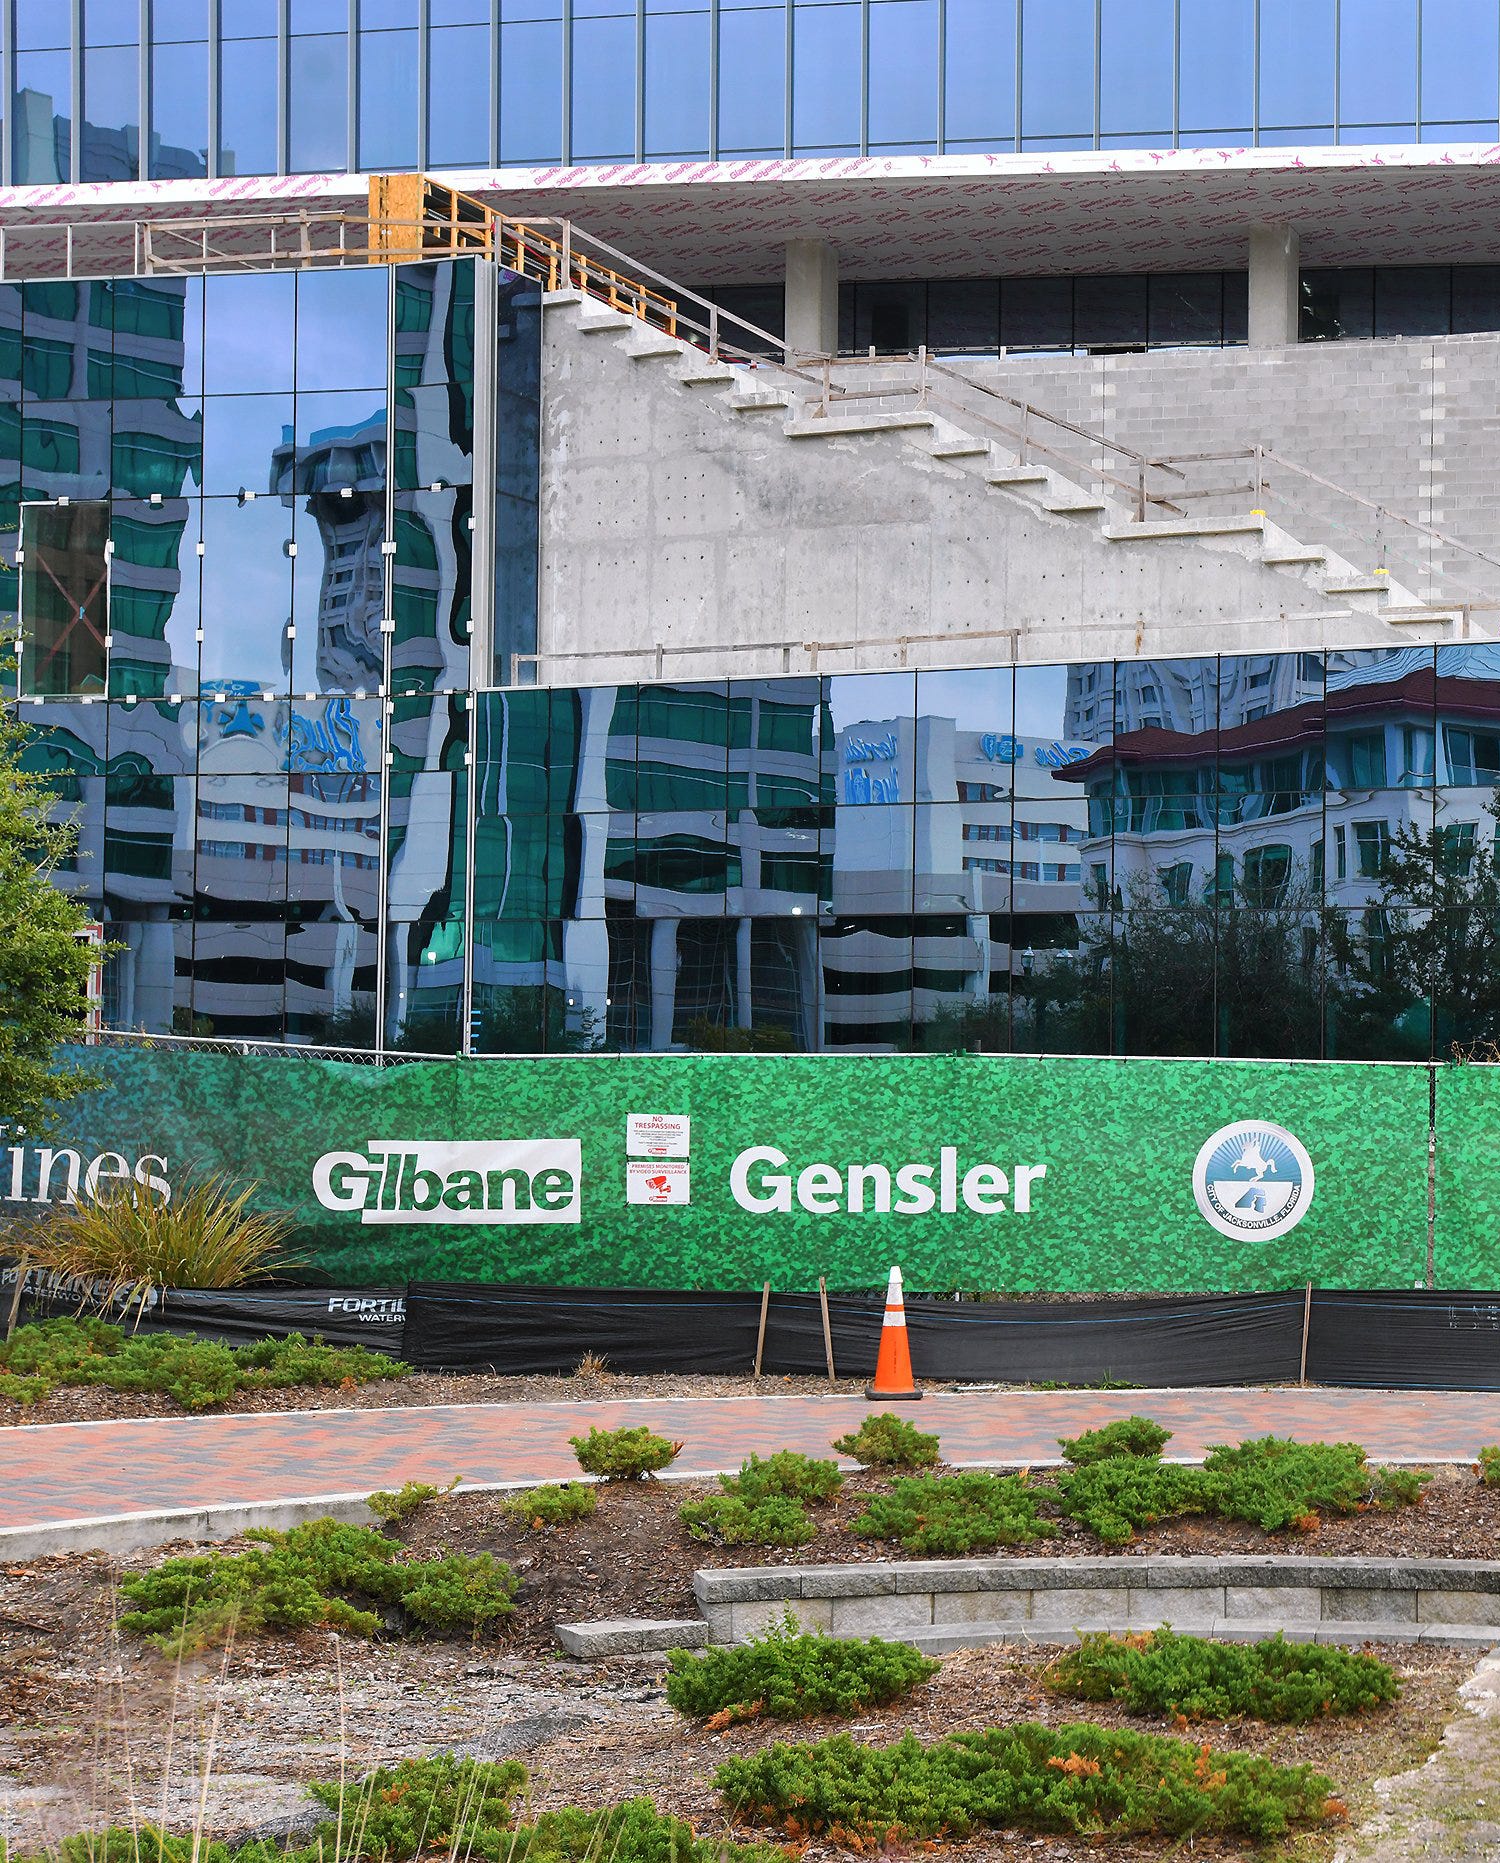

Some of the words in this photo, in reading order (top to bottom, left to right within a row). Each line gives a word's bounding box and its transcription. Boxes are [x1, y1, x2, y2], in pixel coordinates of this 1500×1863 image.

[635, 1122, 681, 1130] TRESPASSING
[0, 1125, 172, 1212] ines
[313, 1151, 575, 1211] Gilbane
[730, 1145, 1047, 1214] Gensler
[1206, 1184, 1218, 1203] CITY
[1214, 1200, 1225, 1213] OF
